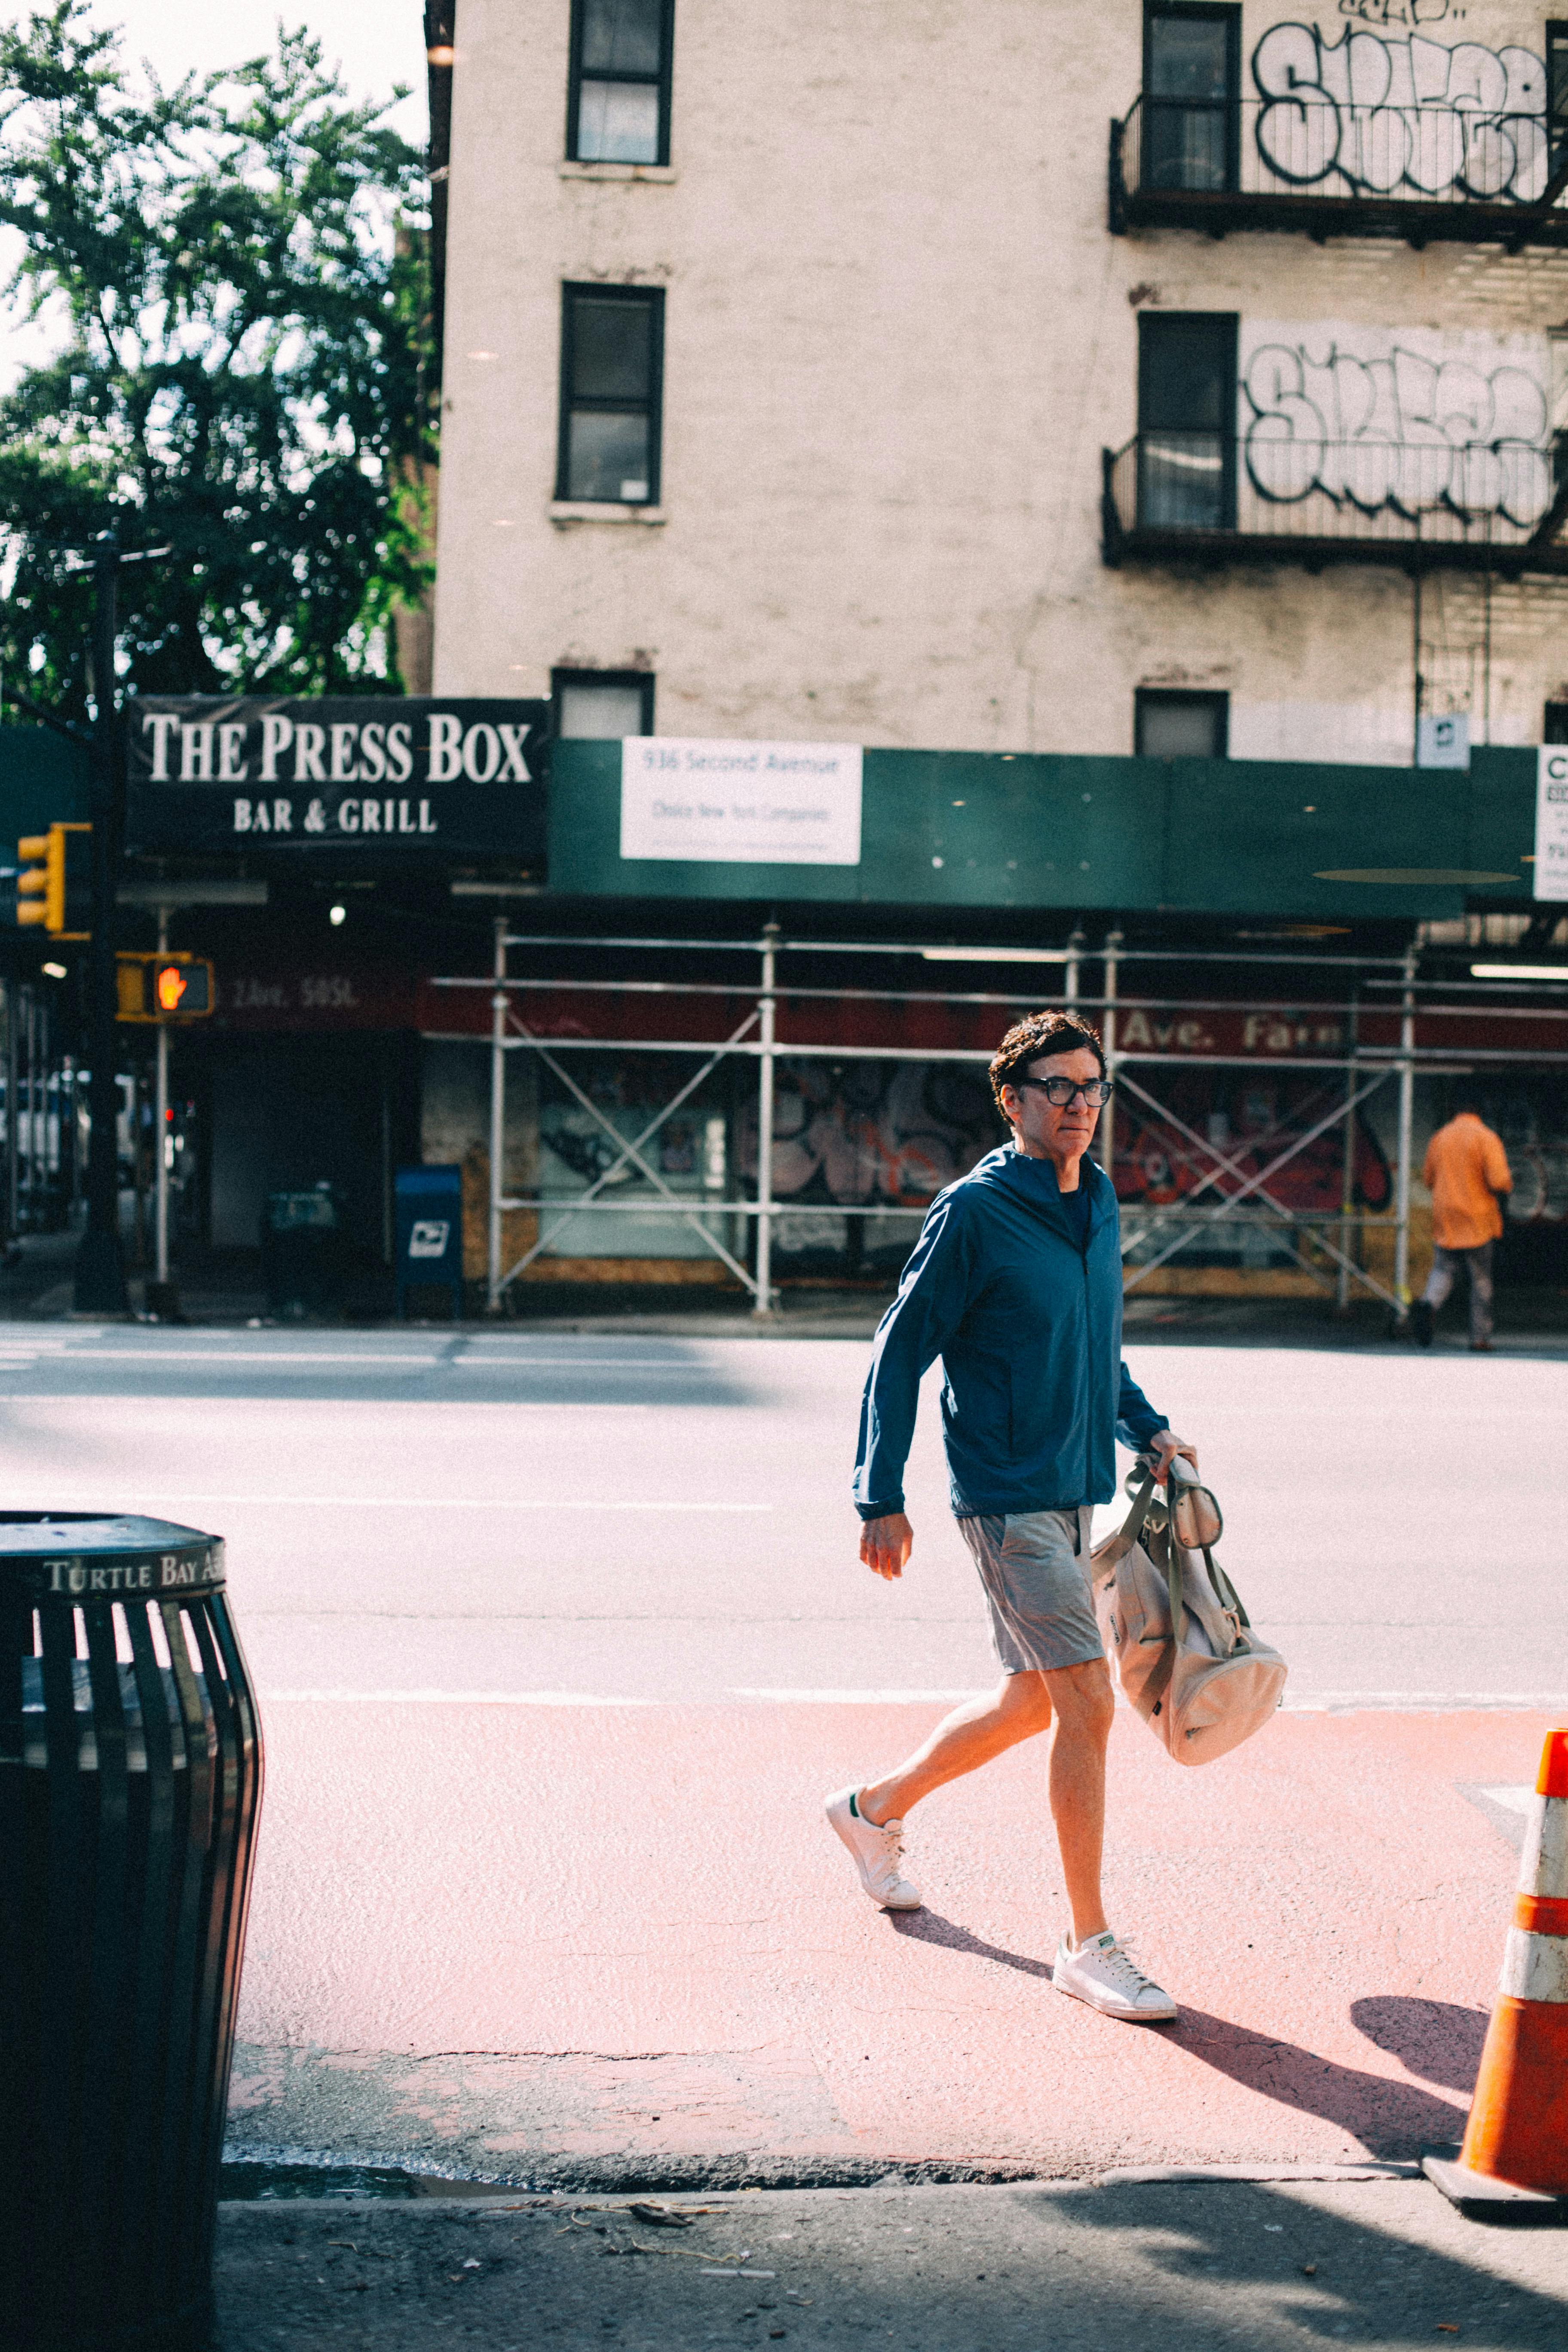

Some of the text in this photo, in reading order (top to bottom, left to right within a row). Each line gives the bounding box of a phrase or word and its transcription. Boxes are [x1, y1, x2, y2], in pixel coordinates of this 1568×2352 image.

[143, 713, 532, 783] THE PRESS BOX
[686, 749, 757, 772] Second
[765, 753, 839, 774] Avenue
[233, 798, 438, 833] BAR & GRILL
[1121, 1010, 1215, 1047] Ave.
[44, 1562, 152, 1591] TURTLE
[160, 1555, 197, 1586] BAY
